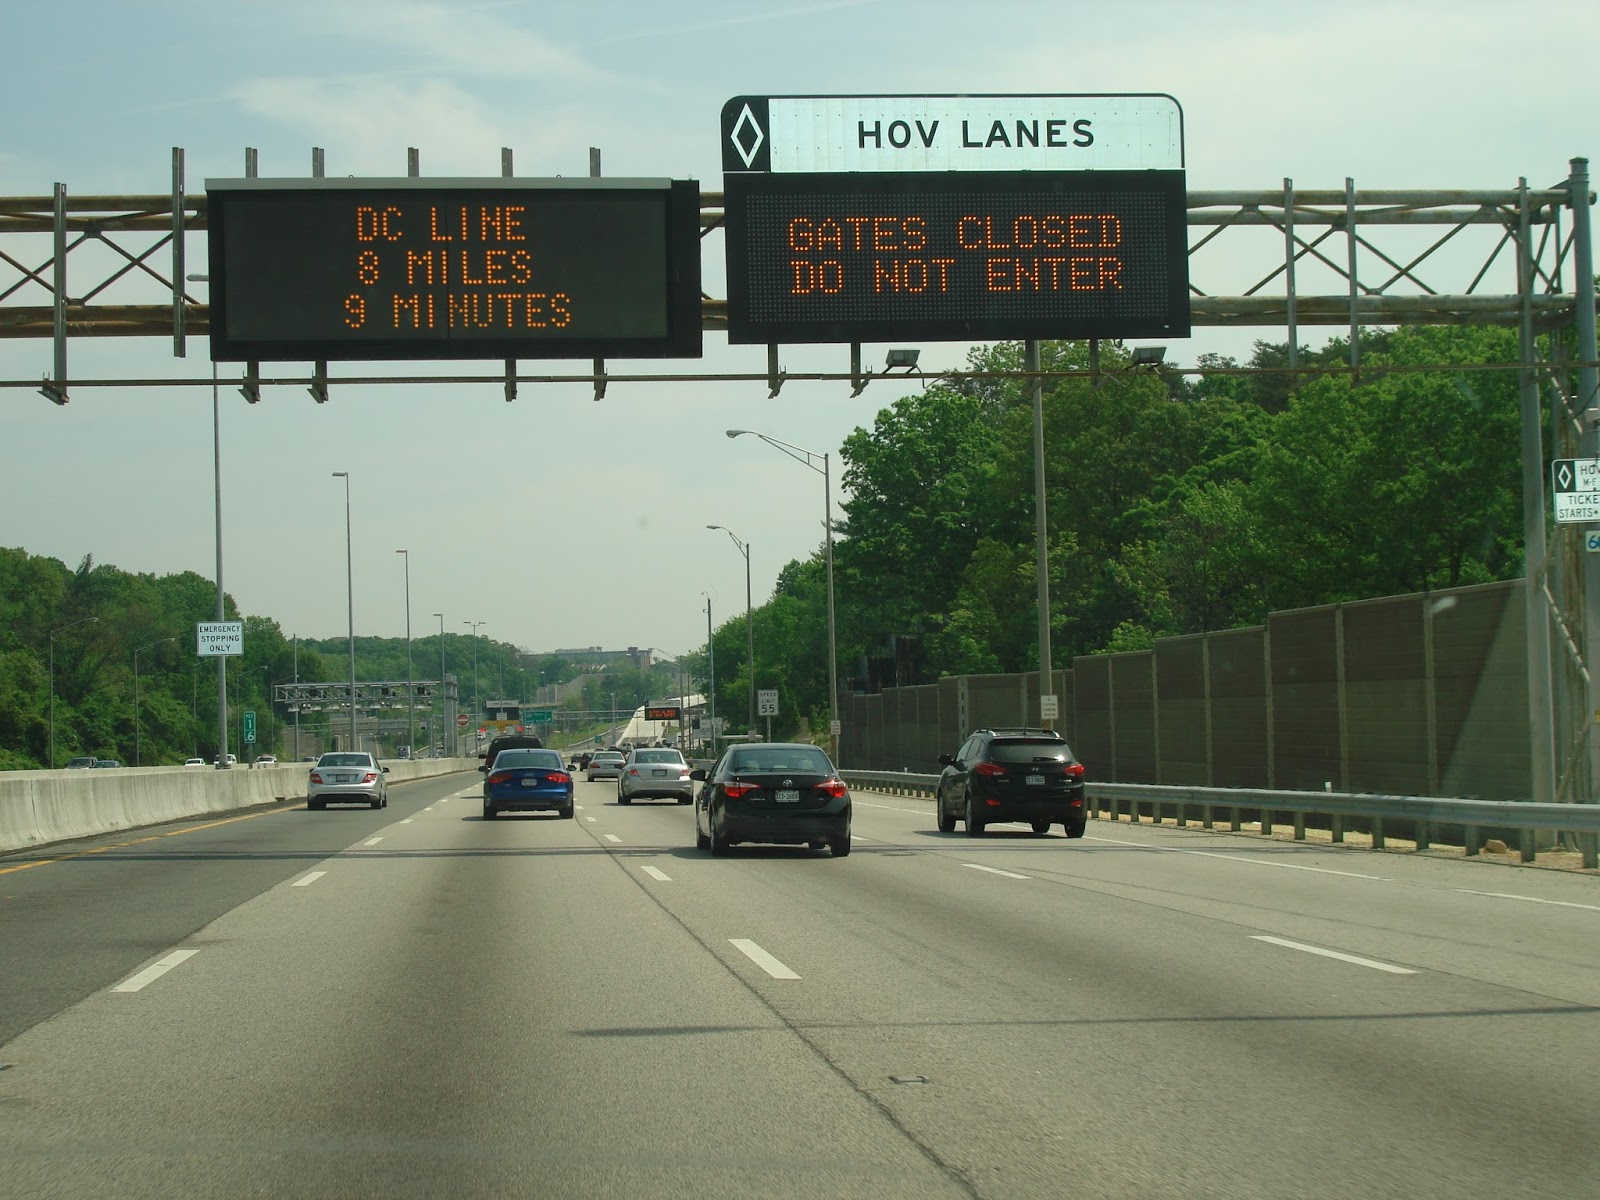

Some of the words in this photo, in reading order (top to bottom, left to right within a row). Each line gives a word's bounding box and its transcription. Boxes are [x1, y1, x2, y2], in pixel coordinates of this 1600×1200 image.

[857, 120, 939, 149] HOV
[962, 119, 1095, 148] LANES
[356, 206, 402, 241] DC
[430, 206, 526, 241] LINE
[788, 216, 927, 251] GATES
[957, 214, 1122, 250] CLOSED
[357, 250, 379, 285] 8
[407, 250, 532, 285] MILES
[790, 259, 844, 294] DO
[875, 258, 956, 293] NOT
[987, 257, 1124, 291] ENTER
[345, 294, 366, 328] 9
[393, 294, 572, 328] MINUTES
[1567, 495, 1600, 505] TICKE
[1559, 507, 1593, 518] STARTS
[199, 625, 241, 633] EMERGENCY
[201, 635, 240, 643] STOPPING
[209, 644, 231, 652] ONLY
[761, 704, 775, 713] 55
